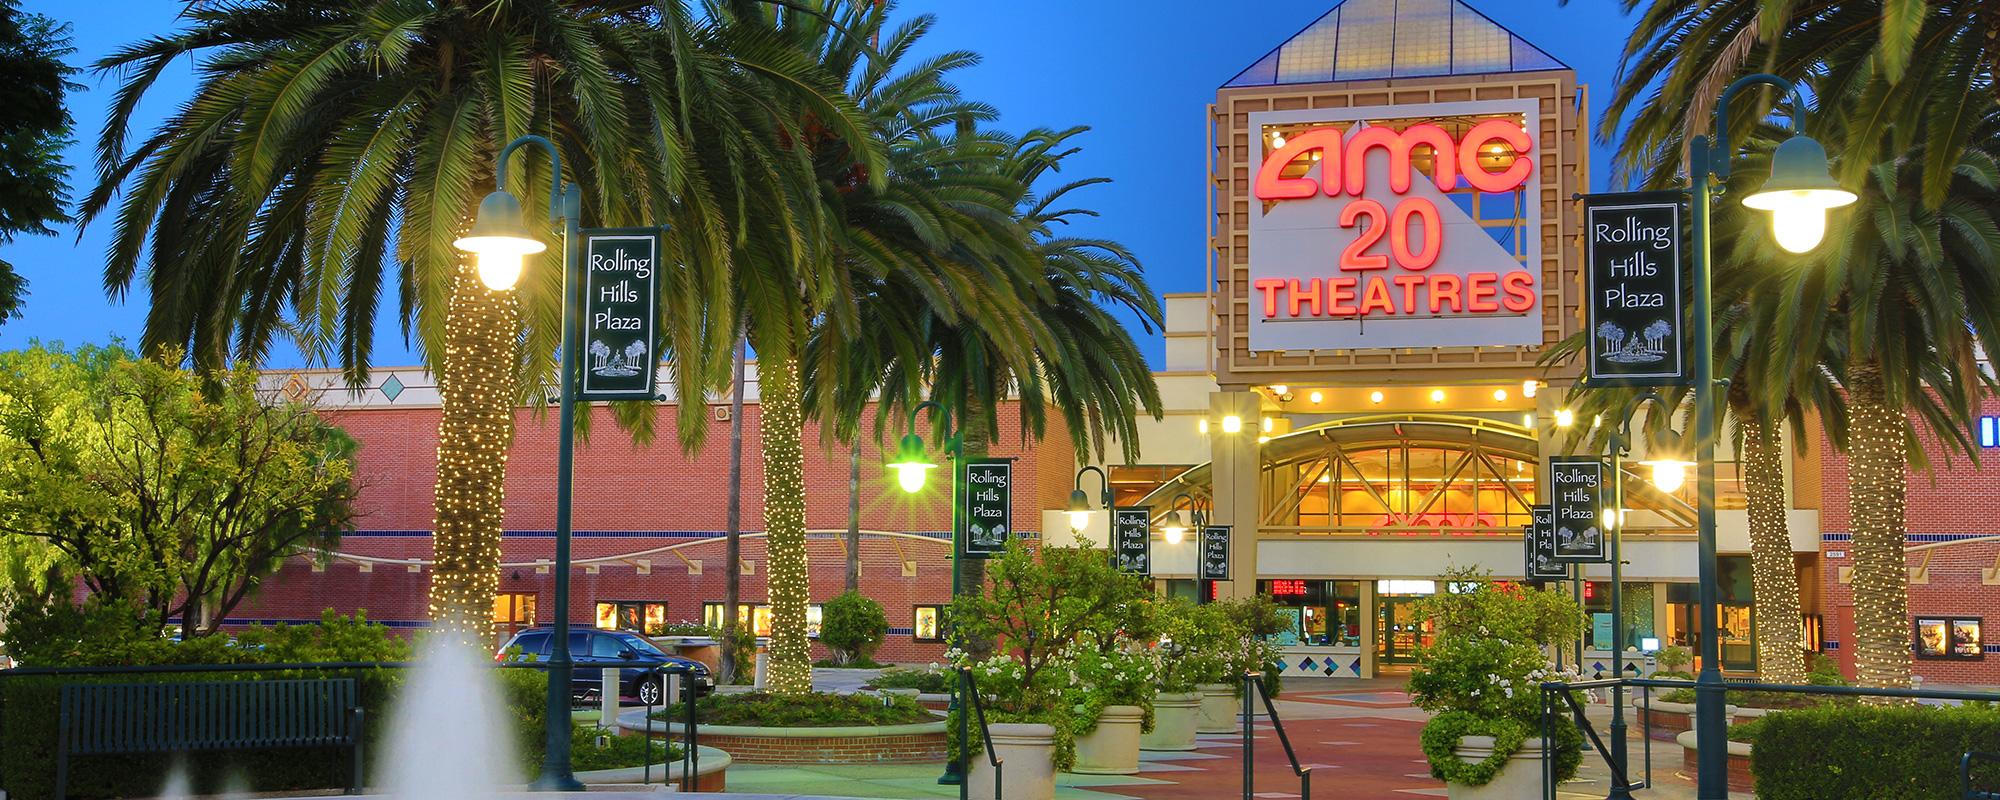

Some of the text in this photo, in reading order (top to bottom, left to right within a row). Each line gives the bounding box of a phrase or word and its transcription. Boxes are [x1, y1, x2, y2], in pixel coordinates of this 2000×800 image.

[1254, 120, 1532, 199] amc
[1339, 197, 1442, 272] 20
[1595, 216, 1671, 250] Rolling
[591, 248, 651, 279] Rolling
[1610, 250, 1657, 278] Hills
[600, 280, 638, 303] Hills
[1255, 271, 1536, 318] THEATRES
[1605, 282, 1664, 309] Plaza
[595, 307, 642, 330] Plaza
[970, 472, 1007, 488] Rolling
[1555, 468, 1597, 488] Rolling
[976, 491, 1000, 502] Hills
[1563, 488, 1590, 502] Hills
[973, 507, 1002, 518] Plaza
[1536, 514, 1552, 524] Roll
[1561, 505, 1594, 519] Plaza
[1119, 515, 1147, 528] Rolling
[1124, 529, 1142, 539] Hills
[1205, 532, 1228, 543] Rolling
[1122, 540, 1144, 550] Plaza
[1208, 542, 1223, 551] Hills
[1539, 539, 1552, 549] Pla
[1207, 551, 1224, 559] Plaza
